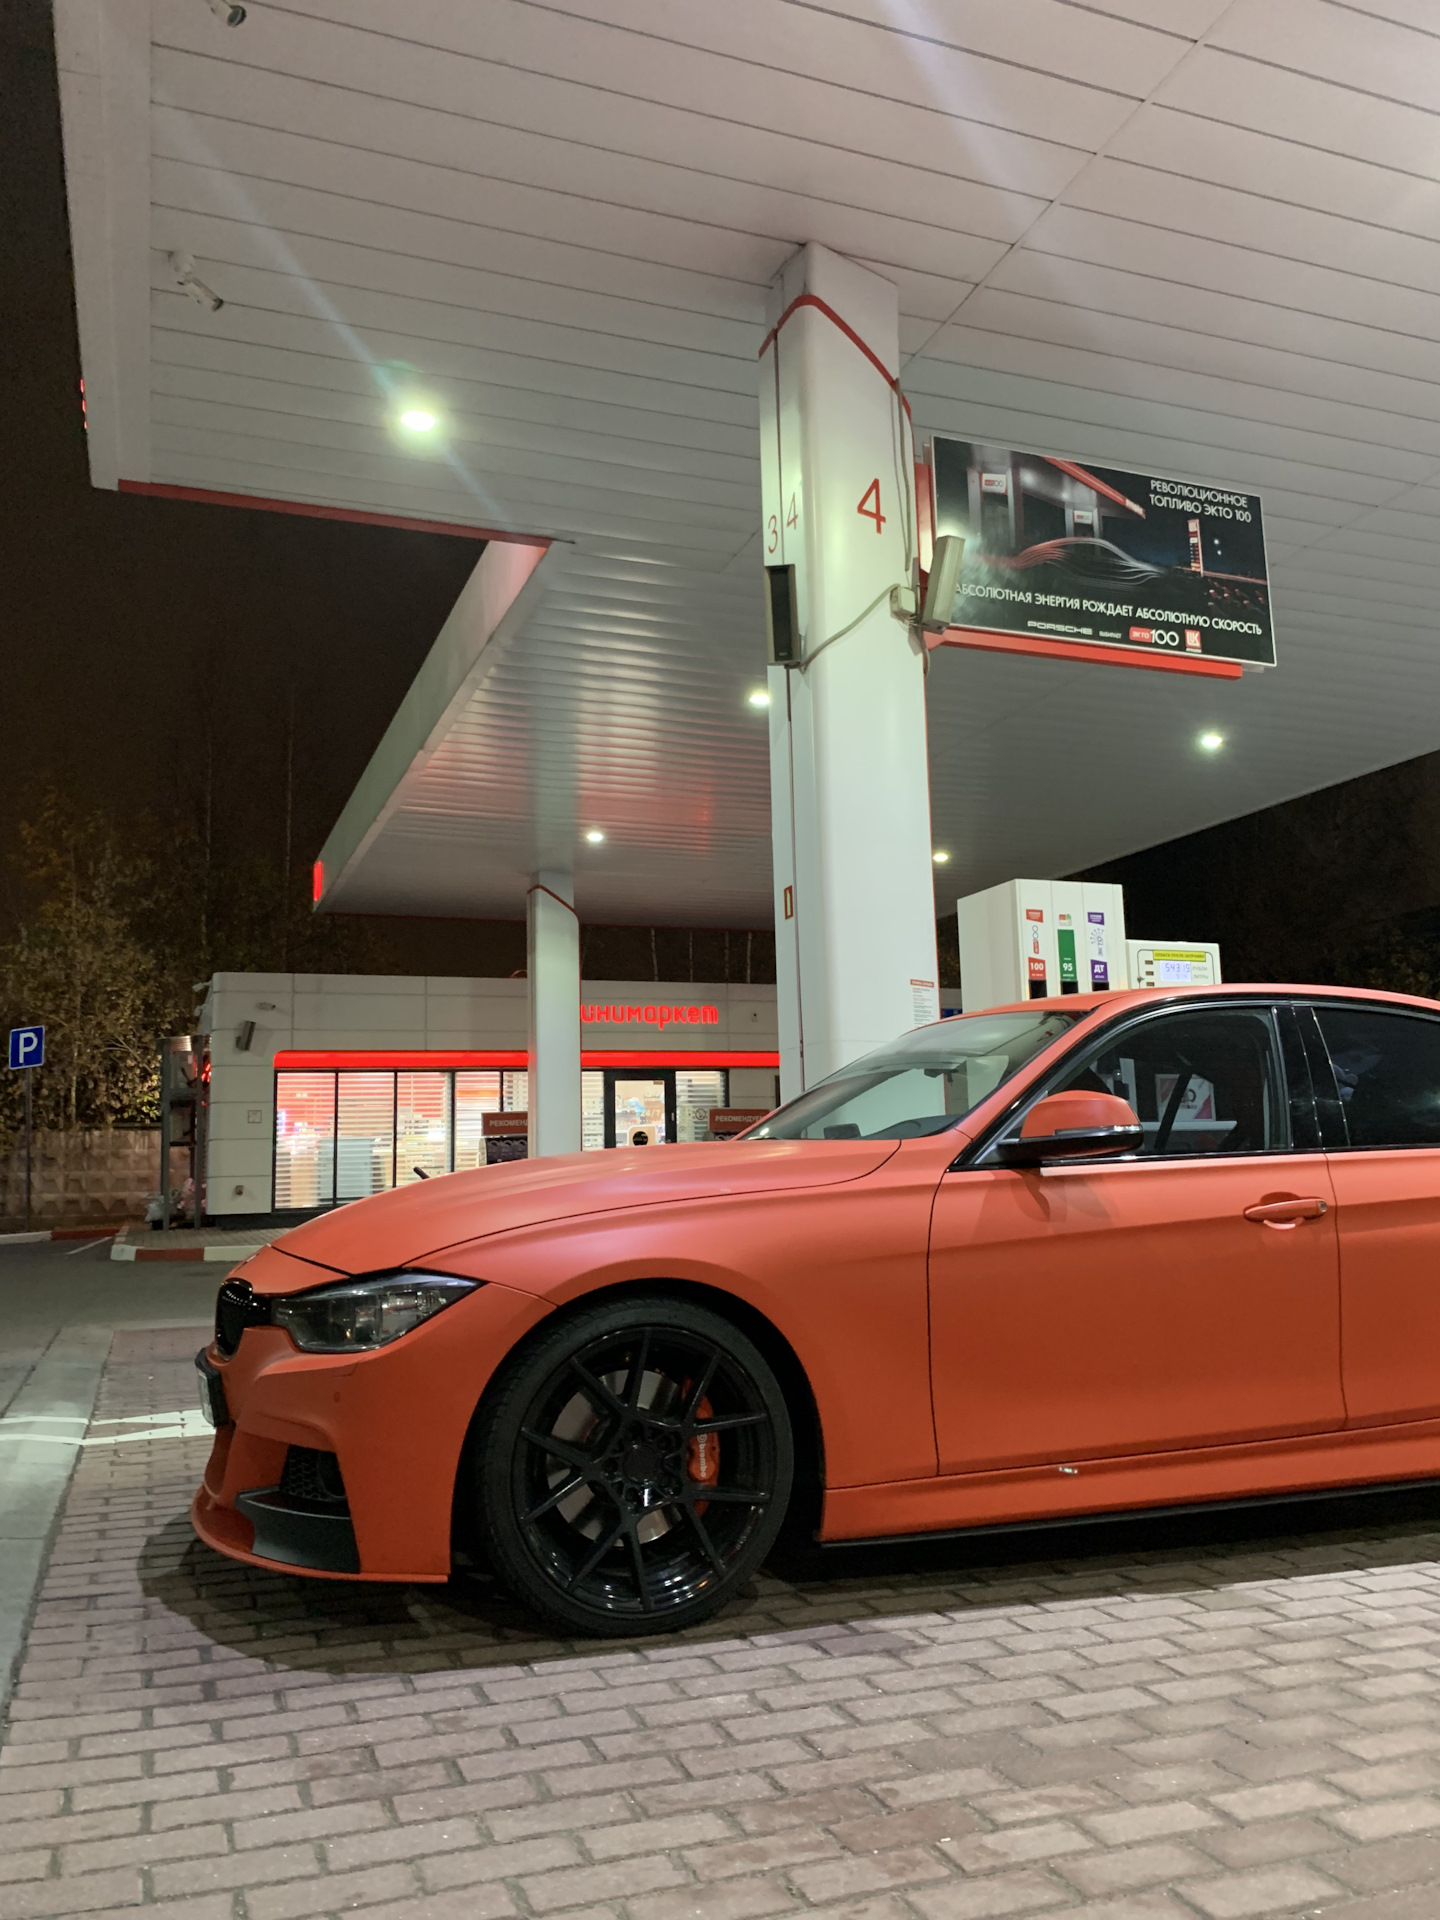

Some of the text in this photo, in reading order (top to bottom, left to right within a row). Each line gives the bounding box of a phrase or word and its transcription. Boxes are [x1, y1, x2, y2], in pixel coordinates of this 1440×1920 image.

[857, 478, 886, 535] 4
[1149, 494, 1202, 514] ТОПЛИВО
[1203, 504, 1233, 519] ЭКТО
[1235, 510, 1252, 523] 100
[1150, 480, 1248, 508] РЕВОЛЮЦИОННОЕ
[786, 492, 798, 531] 4
[767, 515, 778, 554] 3
[956, 583, 1263, 636] АБСОЛЮТНАЯ ЭНЕРГИЯ РОЖДАЕТ АБСОЛЮТНУЮ СКОРОСТЬ
[1027, 620, 1093, 636] PORSCHE
[1030, 962, 1044, 971] 100
[1062, 962, 1073, 971] 95
[1094, 964, 1105, 973] ДТ
[19, 1032, 38, 1064] P
